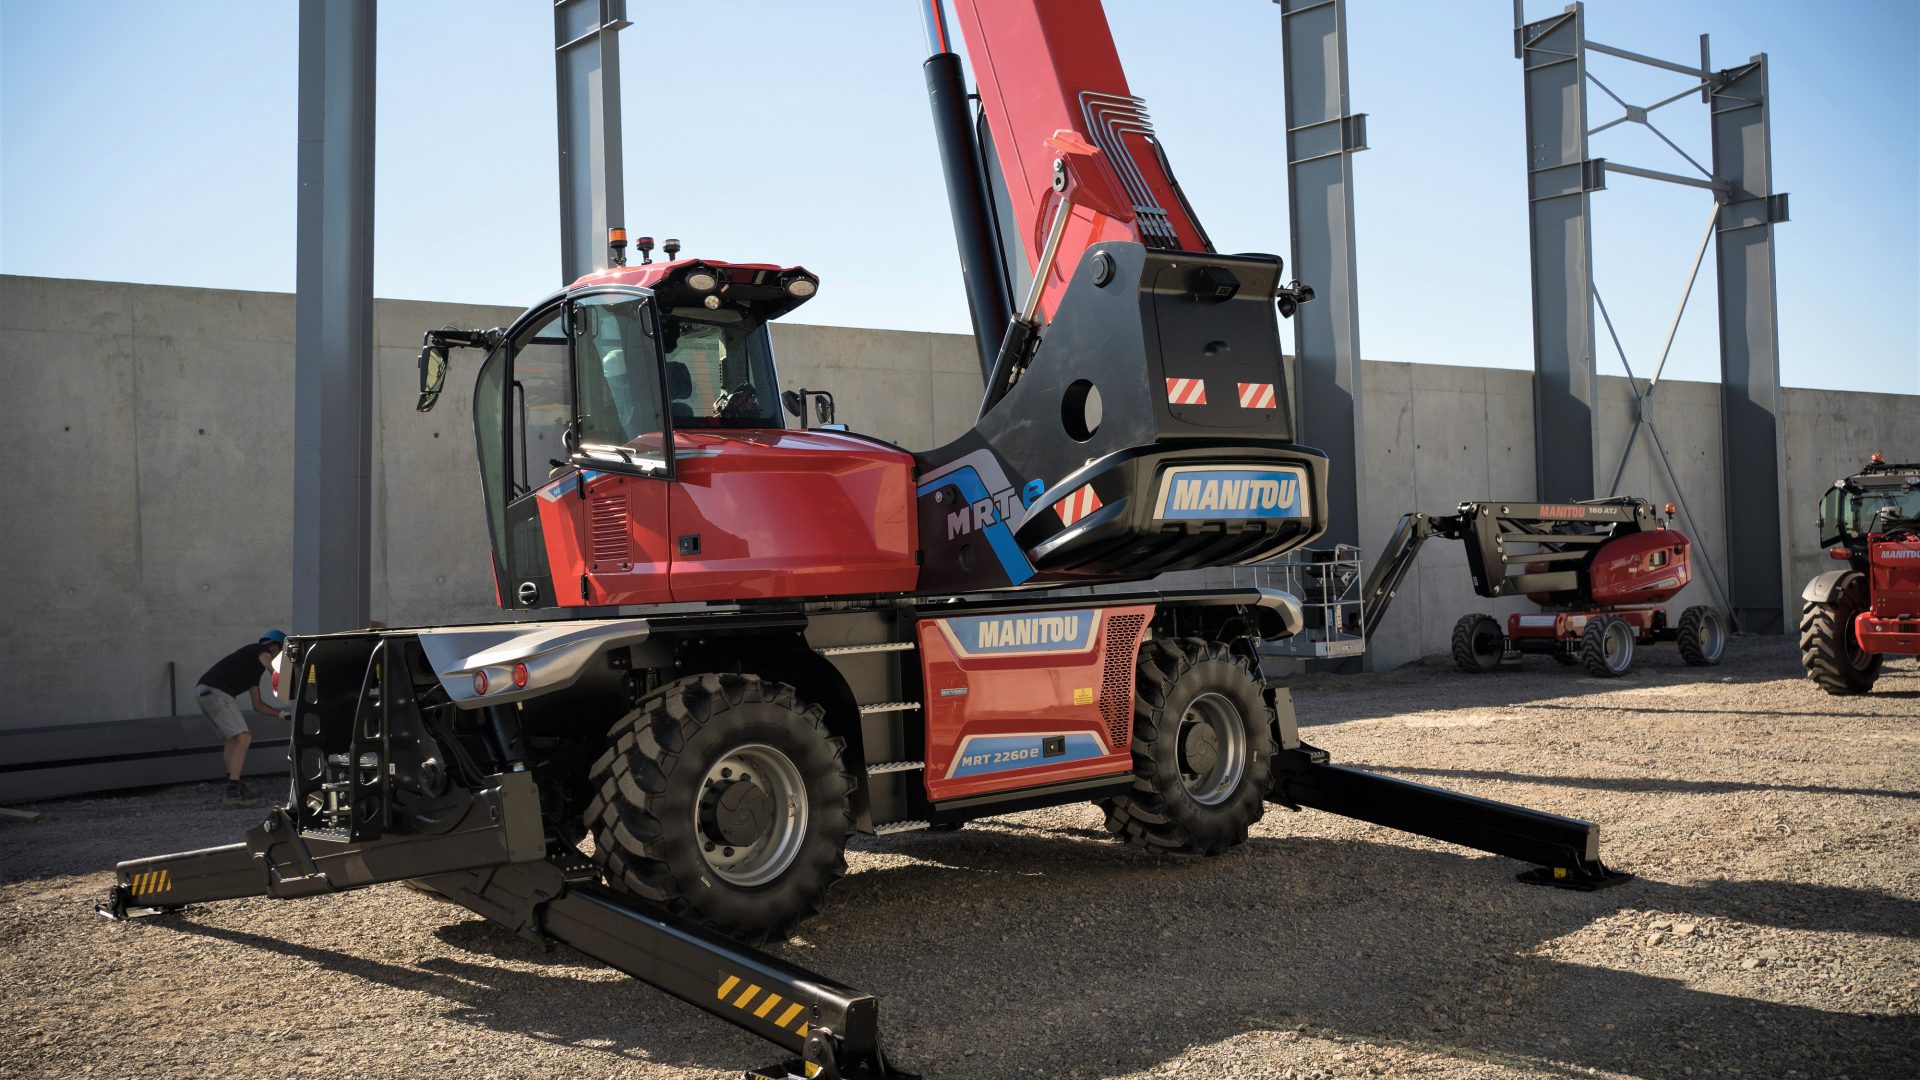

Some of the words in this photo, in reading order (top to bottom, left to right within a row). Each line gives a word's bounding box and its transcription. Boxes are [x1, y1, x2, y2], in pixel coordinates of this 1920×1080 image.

[1172, 479, 1297, 510] MANITOU
[1539, 504, 1585, 518] MANITOU
[978, 616, 1078, 648] MANITOU
[962, 754, 991, 767] MRT
